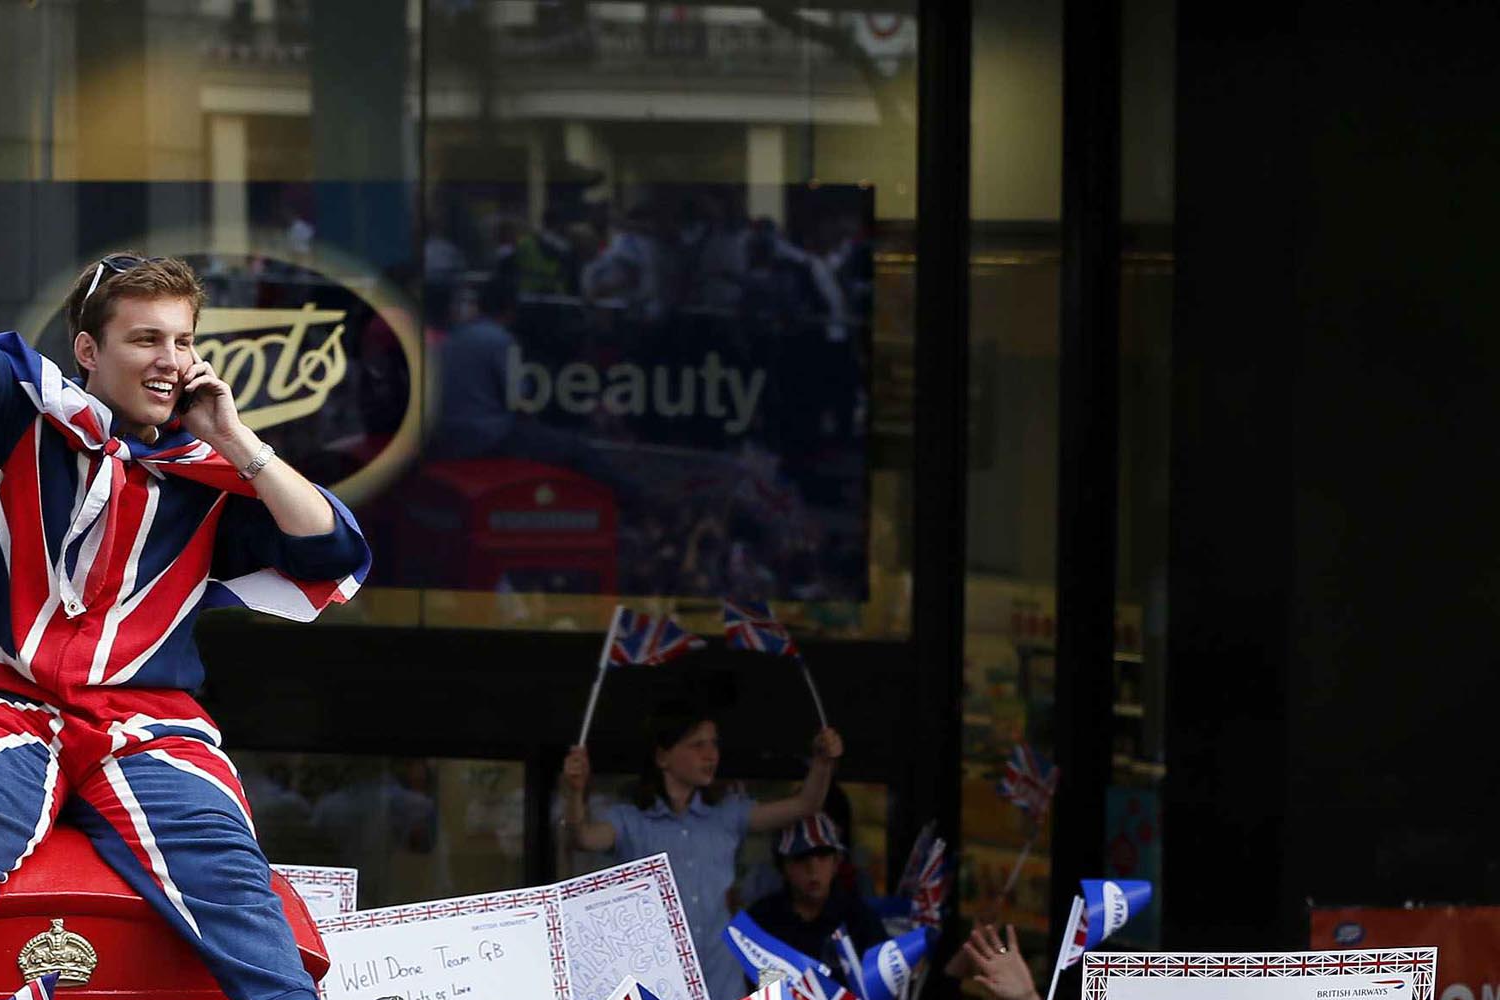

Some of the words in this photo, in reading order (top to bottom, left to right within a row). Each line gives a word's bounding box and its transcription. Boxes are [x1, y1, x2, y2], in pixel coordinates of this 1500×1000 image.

[505, 344, 767, 434] beauty
[339, 960, 380, 992] Well
[385, 956, 424, 980] Done
[432, 945, 471, 969] Team
[478, 940, 505, 961] GB
[1316, 989, 1350, 999] BRITISH
[1352, 987, 1389, 998] AIRWAYS
